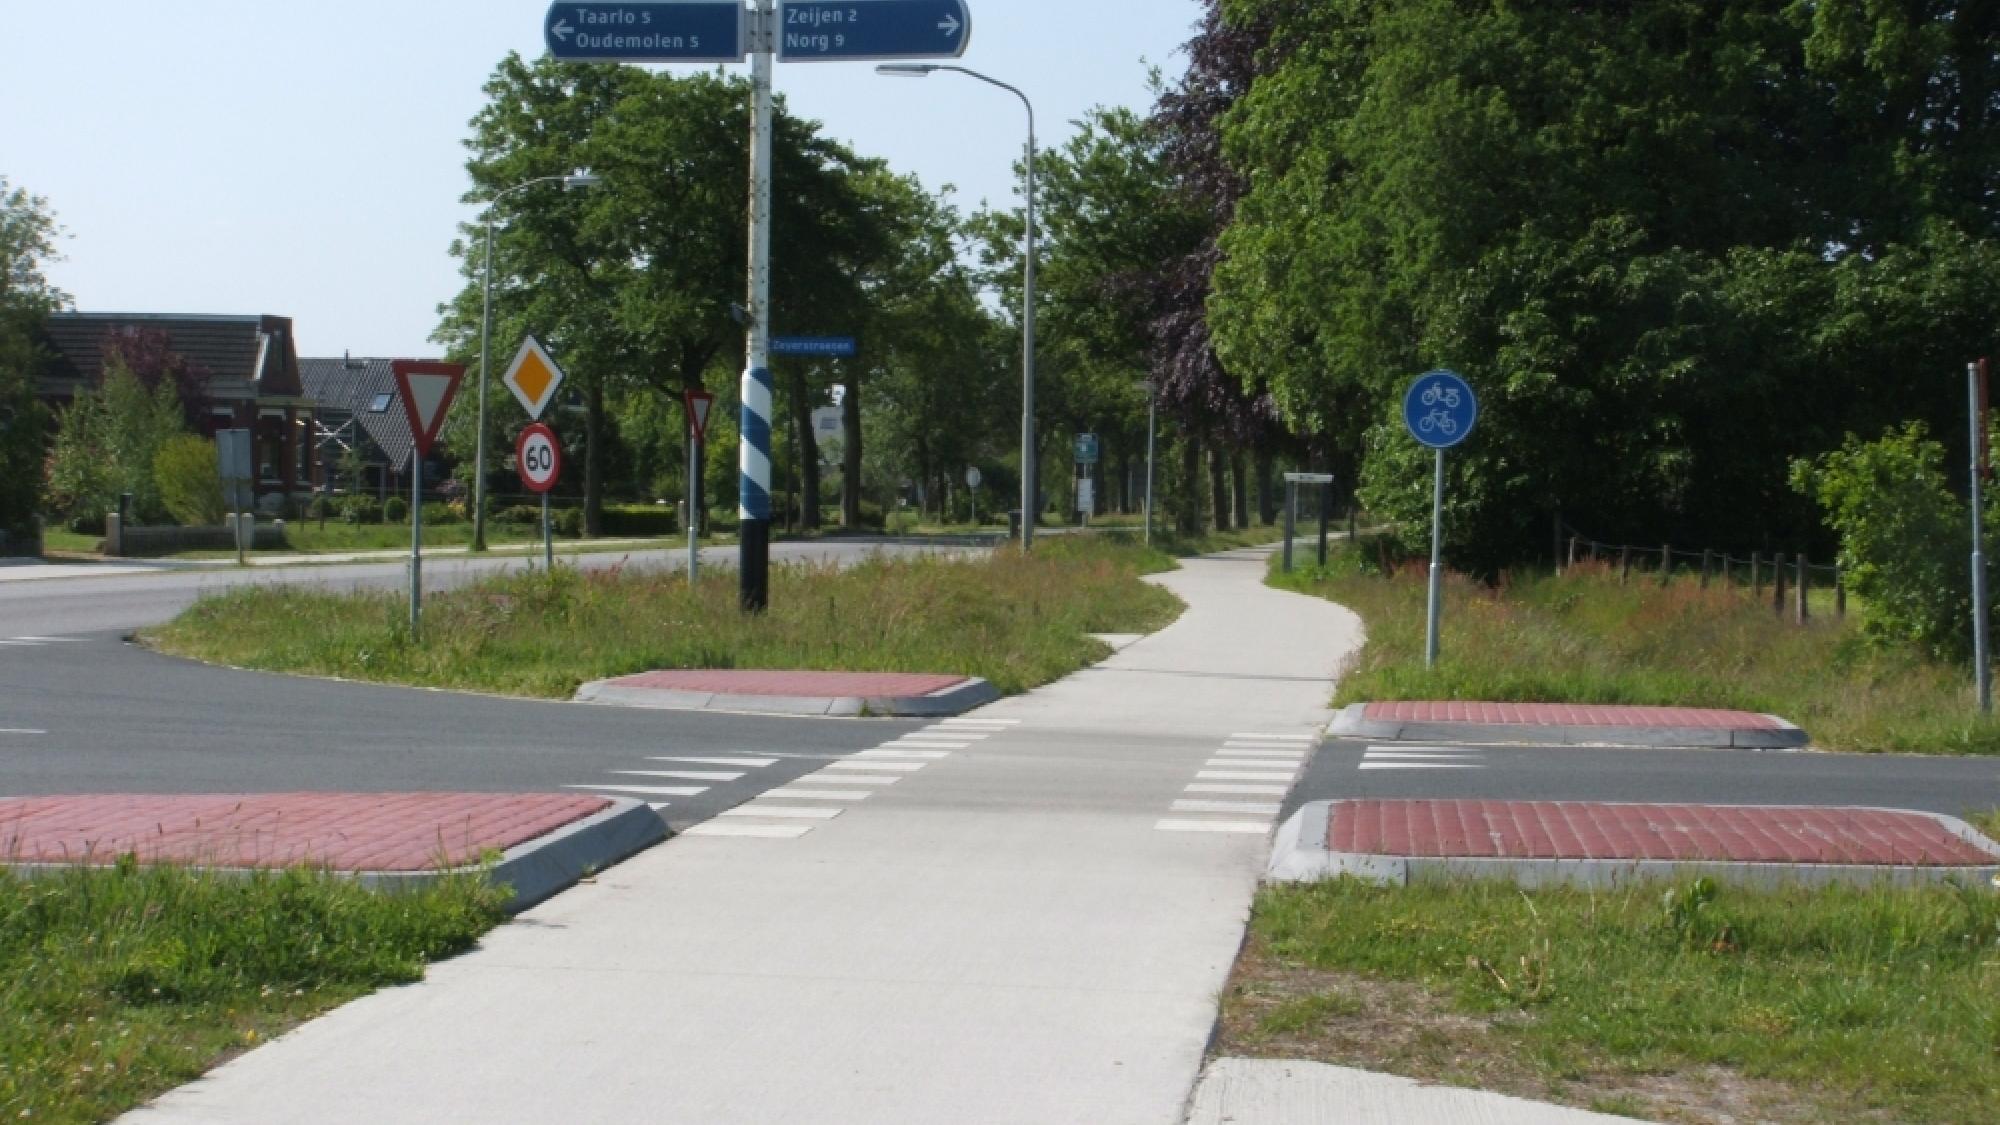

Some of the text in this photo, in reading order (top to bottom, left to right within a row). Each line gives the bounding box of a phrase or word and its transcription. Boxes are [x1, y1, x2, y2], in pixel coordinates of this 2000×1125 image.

[576, 8, 635, 24] Taarlo
[787, 7, 857, 27] Zeijen 2
[576, 33, 683, 48] Oudemolen
[786, 33, 845, 51] Norg 9
[526, 445, 551, 471] 60
